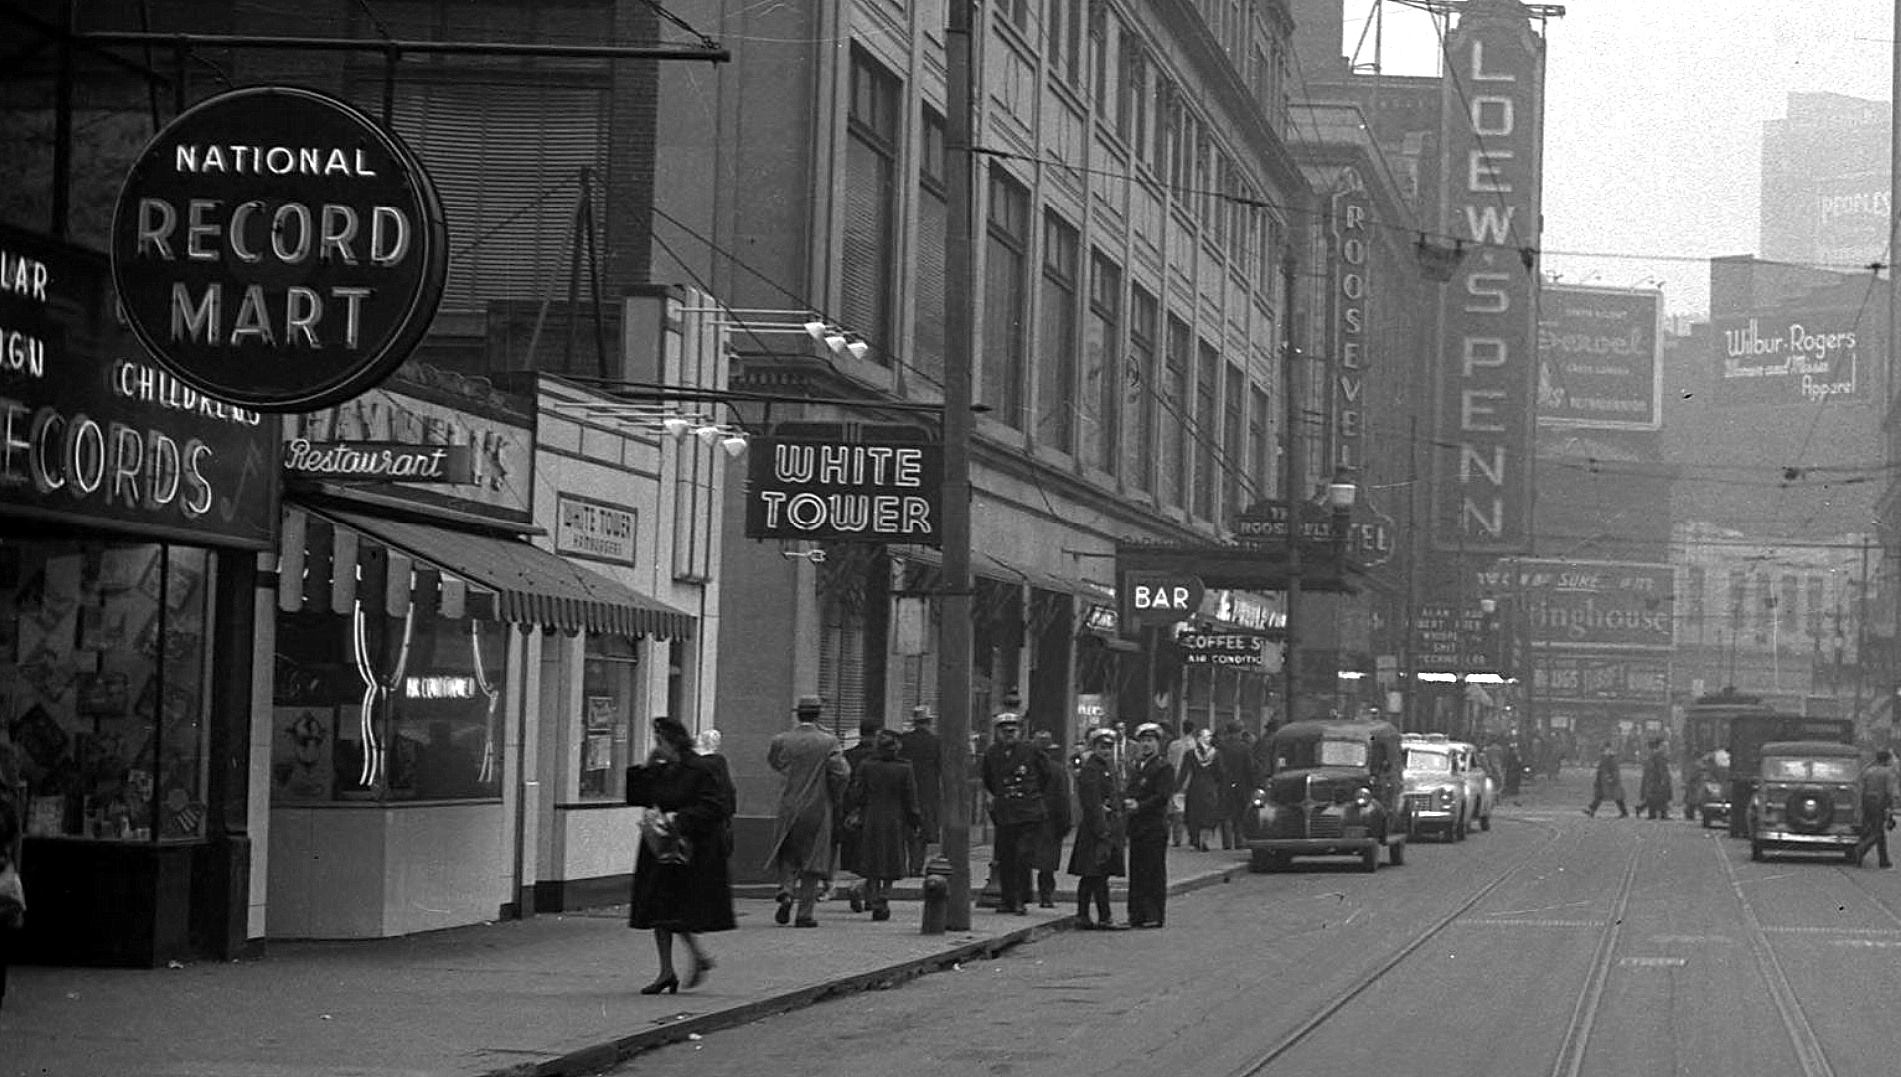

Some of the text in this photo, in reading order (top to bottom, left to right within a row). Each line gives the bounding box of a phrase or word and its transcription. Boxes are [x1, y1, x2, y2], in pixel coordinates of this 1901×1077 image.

[176, 144, 377, 177] NATIONAL
[136, 198, 411, 266] RECORD
[170, 281, 378, 351] MART
[1341, 204, 1367, 472] ROOSEVEL
[284, 438, 448, 478] Restaurant
[774, 444, 923, 487] WHITE
[761, 491, 932, 534] TOWER
[1135, 585, 1189, 610] BAR
[1183, 634, 1243, 651] COFFEE
